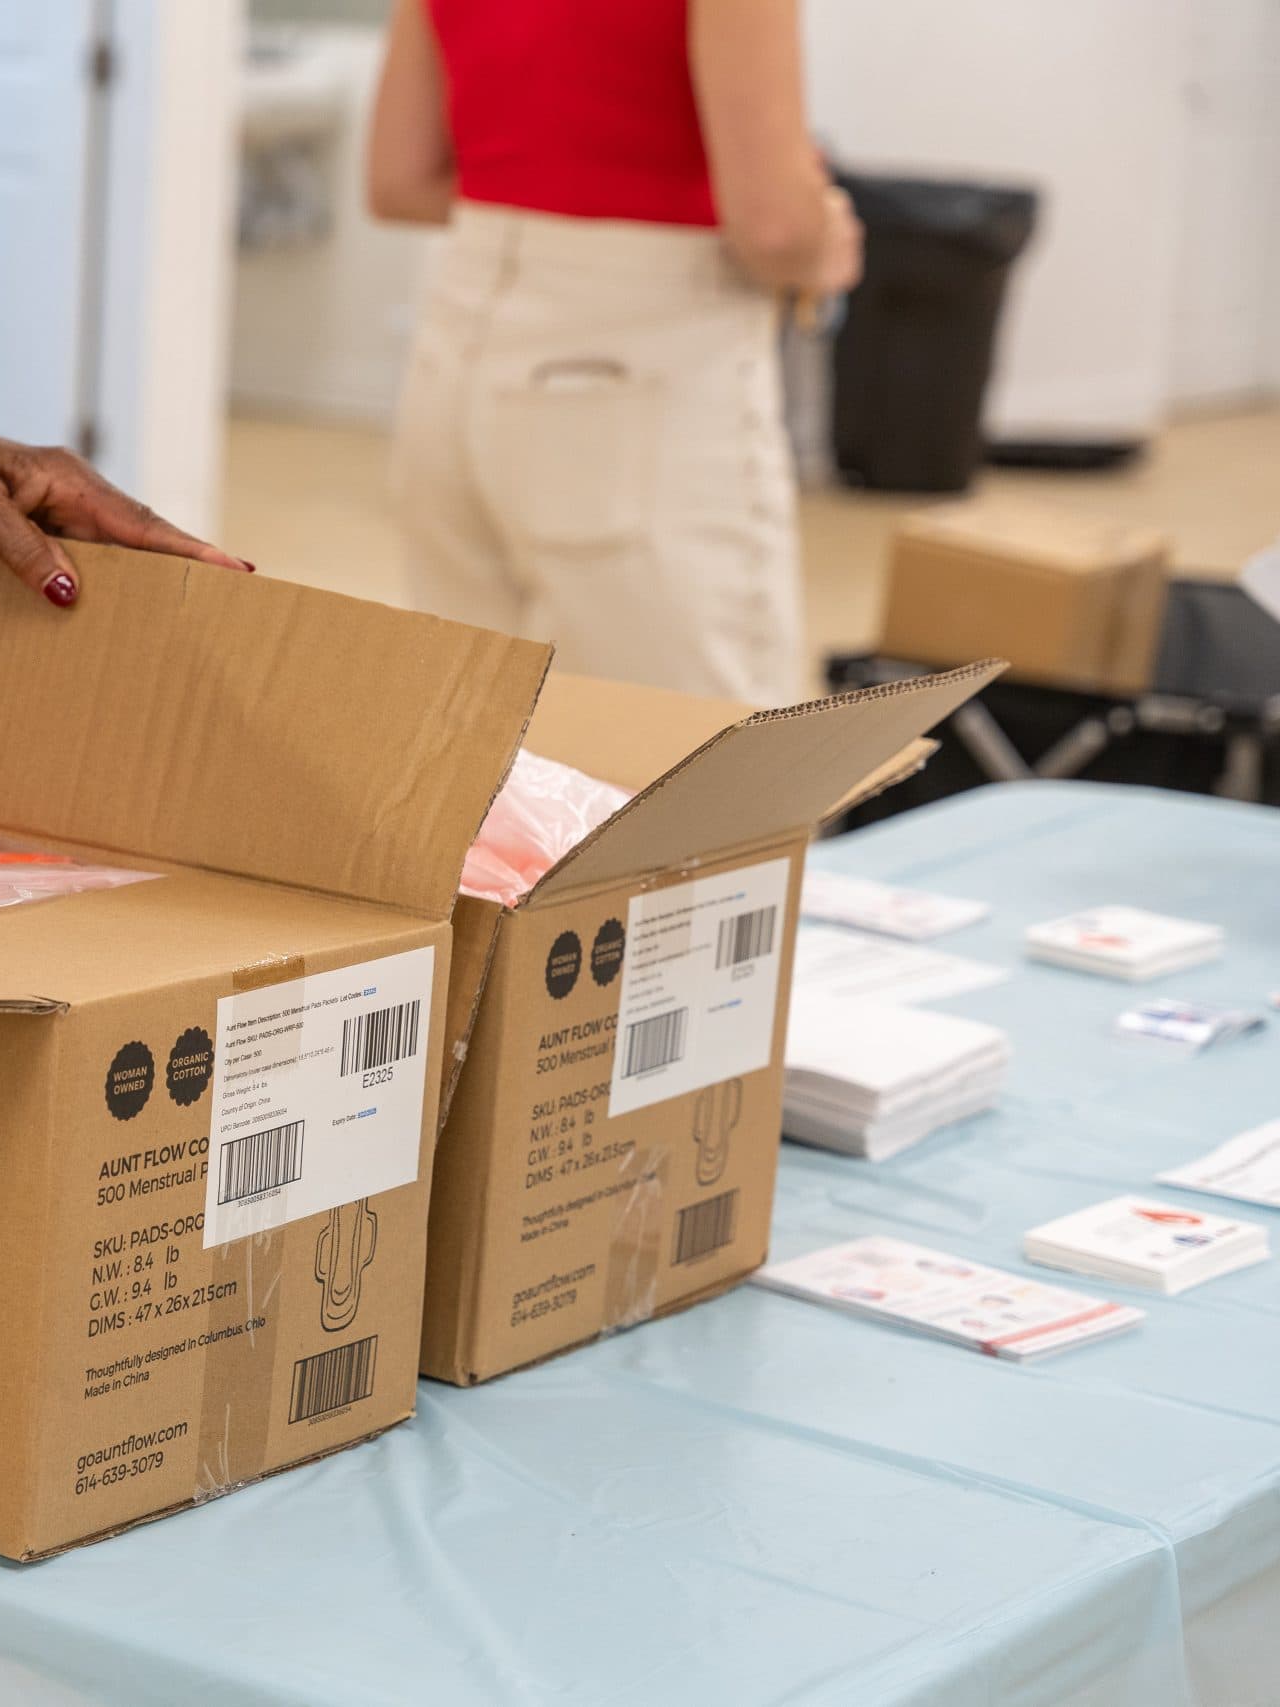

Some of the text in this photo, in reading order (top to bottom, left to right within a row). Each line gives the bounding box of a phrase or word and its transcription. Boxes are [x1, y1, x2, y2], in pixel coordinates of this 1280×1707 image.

[538, 1028, 570, 1052] AUNT
[571, 1017, 603, 1041] FLOW
[172, 1052, 209, 1068] ORGANIC
[536, 1036, 610, 1075] 500 Menstrual
[113, 1066, 148, 1081] WOMAN
[173, 1065, 206, 1081] COTTON
[362, 1066, 394, 1089] E2325
[113, 1080, 145, 1095] OWNED
[99, 1153, 142, 1180] AUNT
[143, 1141, 186, 1169] FLOW
[97, 1183, 125, 1206] 500
[129, 1163, 196, 1198] Menstrual
[93, 1234, 126, 1259] SKU:
[133, 1252, 153, 1273] 8.4
[166, 1245, 180, 1264] lb
[132, 1279, 152, 1300] 9.4
[164, 1272, 178, 1290] lb
[135, 1303, 153, 1321] 47
[85, 1354, 144, 1382] Thoughtfully
[145, 1340, 186, 1363] designed
[188, 1338, 197, 1350] in
[245, 1316, 266, 1332] Ohio
[84, 1370, 150, 1399] Made in China
[77, 1422, 188, 1474] goauntflow.com
[75, 1451, 164, 1495] 614-639-3079
